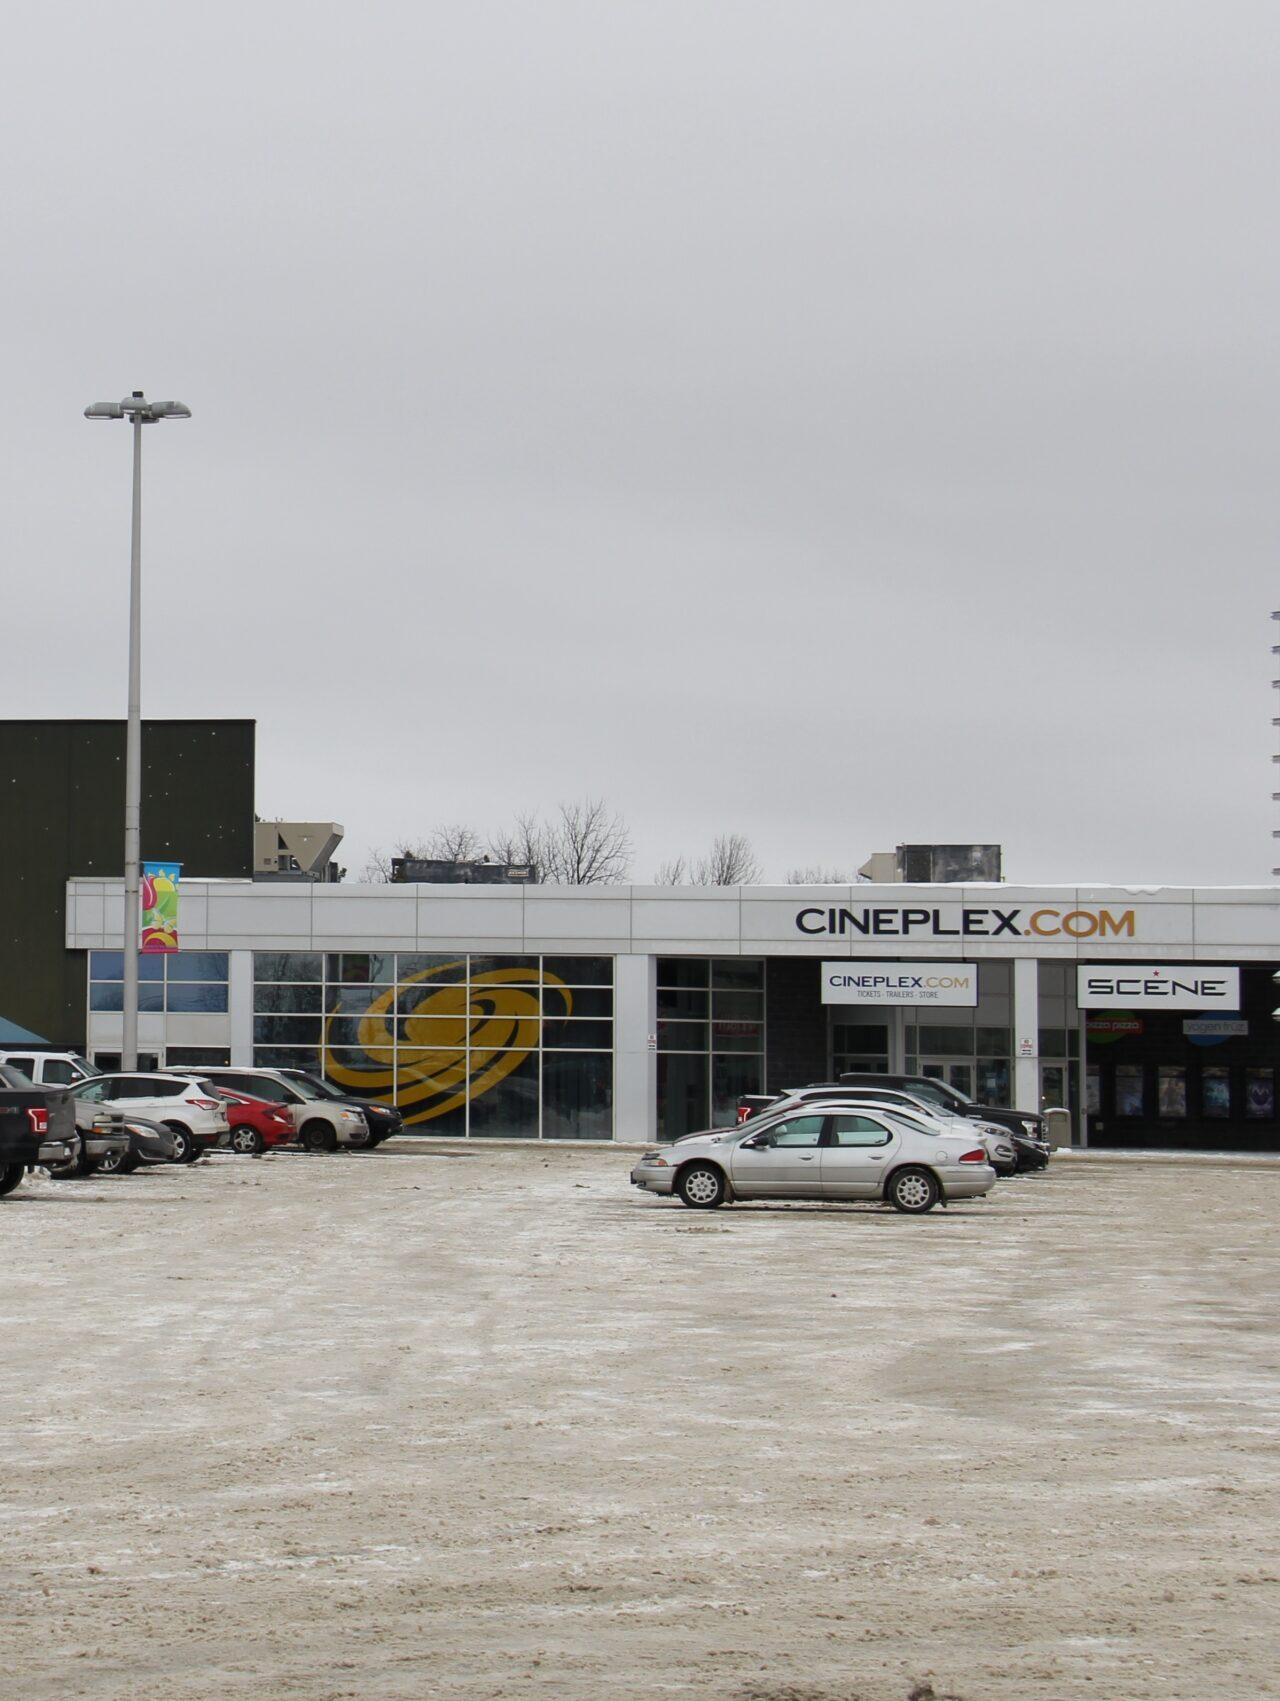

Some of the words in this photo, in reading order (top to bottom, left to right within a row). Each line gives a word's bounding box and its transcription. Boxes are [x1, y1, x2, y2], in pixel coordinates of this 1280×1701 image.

[795, 908, 1135, 937] CINEPLEX.COM
[829, 975, 970, 989] CINEPLEX.COM
[1087, 979, 1229, 996] SCENE
[857, 990, 881, 998] TICKETS
